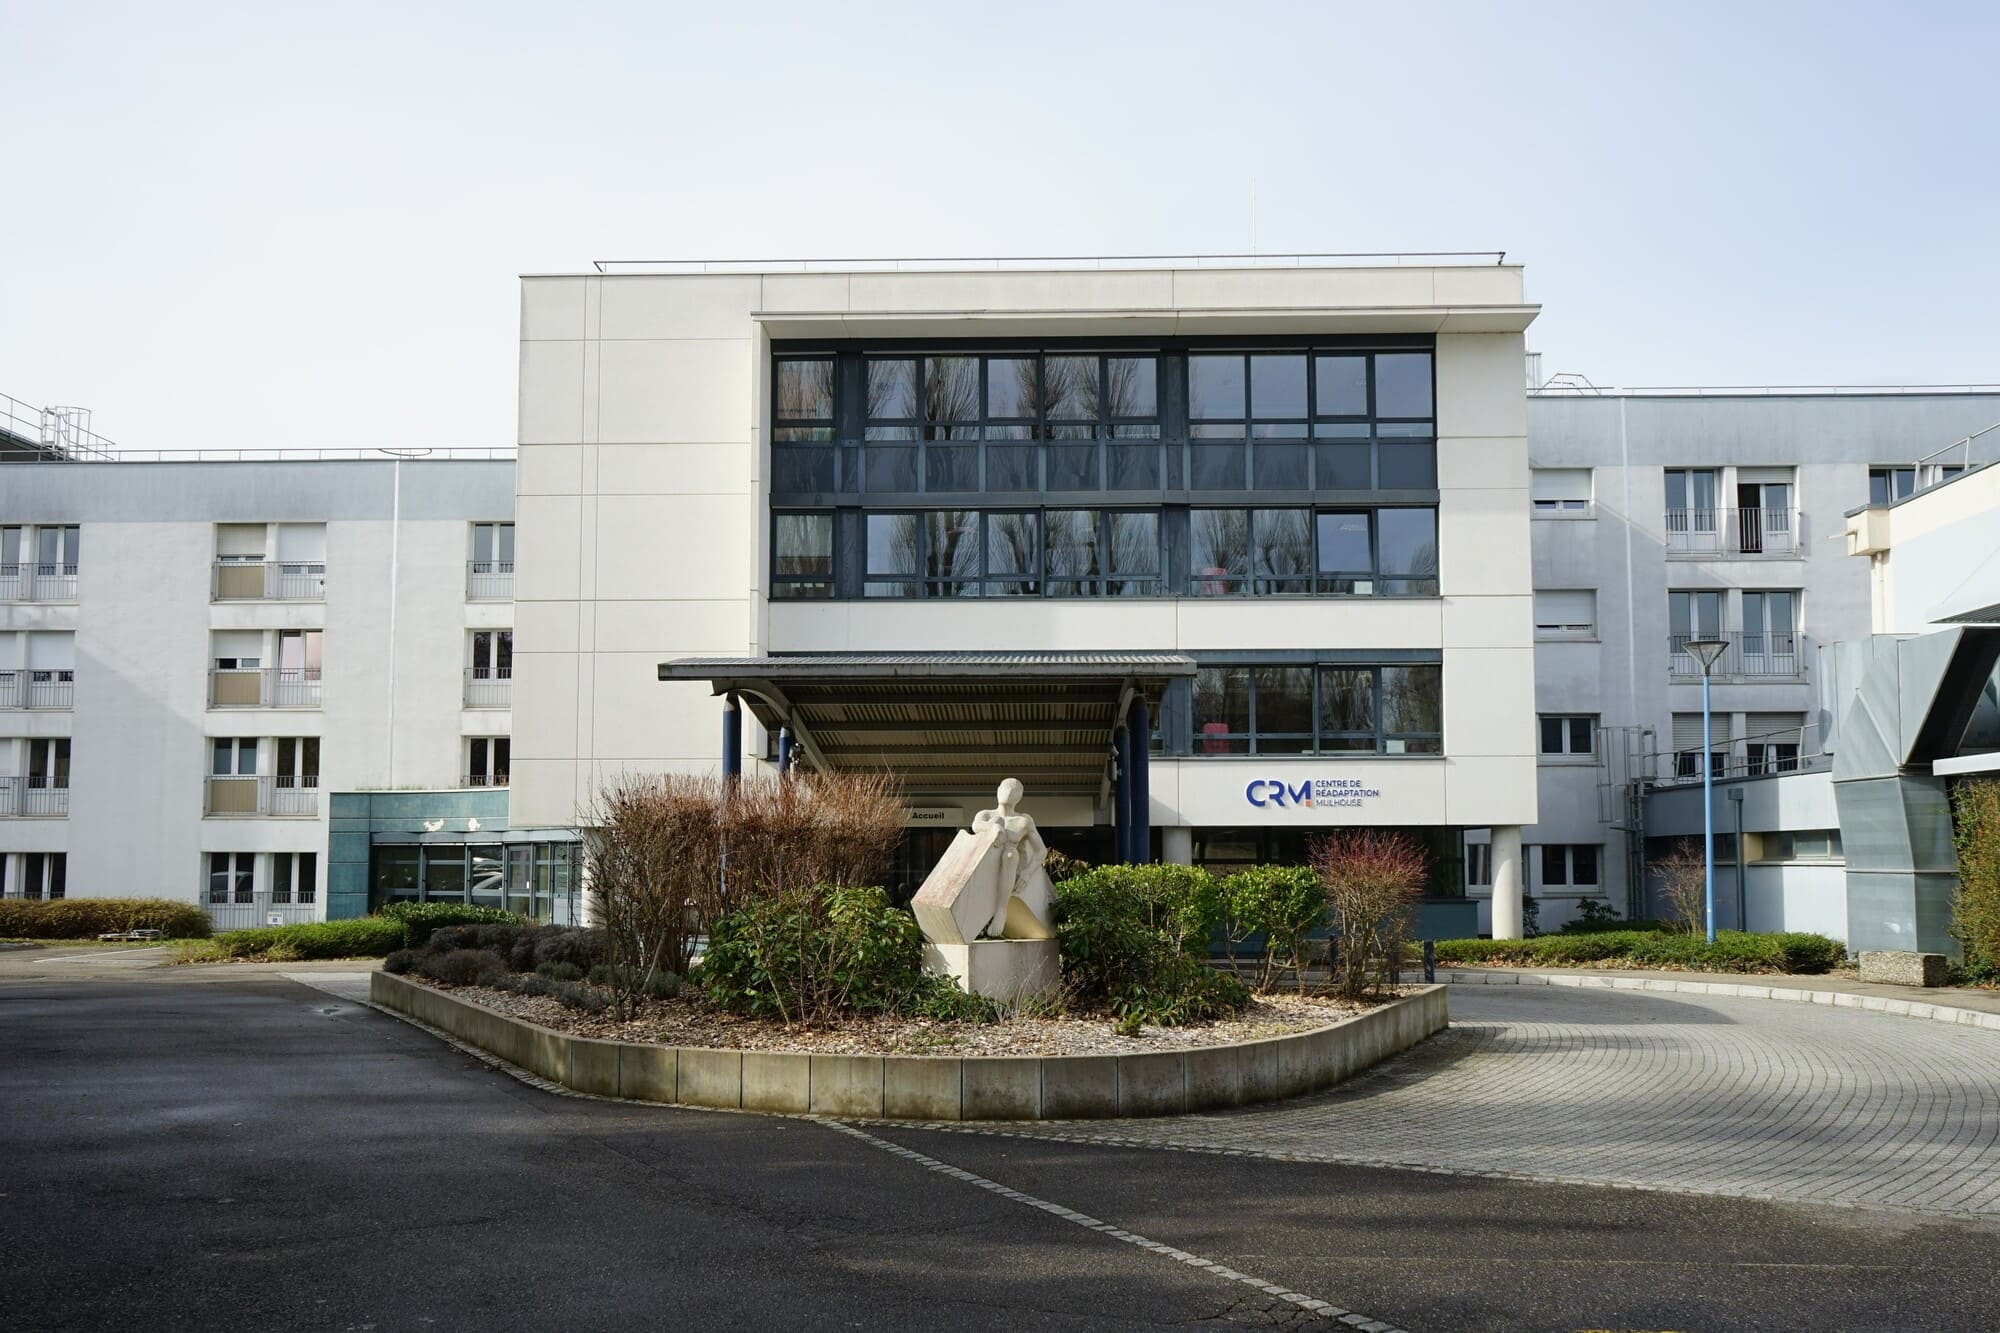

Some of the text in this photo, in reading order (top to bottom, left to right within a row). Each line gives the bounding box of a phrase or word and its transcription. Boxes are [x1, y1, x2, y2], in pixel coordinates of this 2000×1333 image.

[1246, 780, 1311, 807] CRM
[1315, 788, 1379, 797] RÉADAPTATION
[912, 811, 945, 819] Accueil
